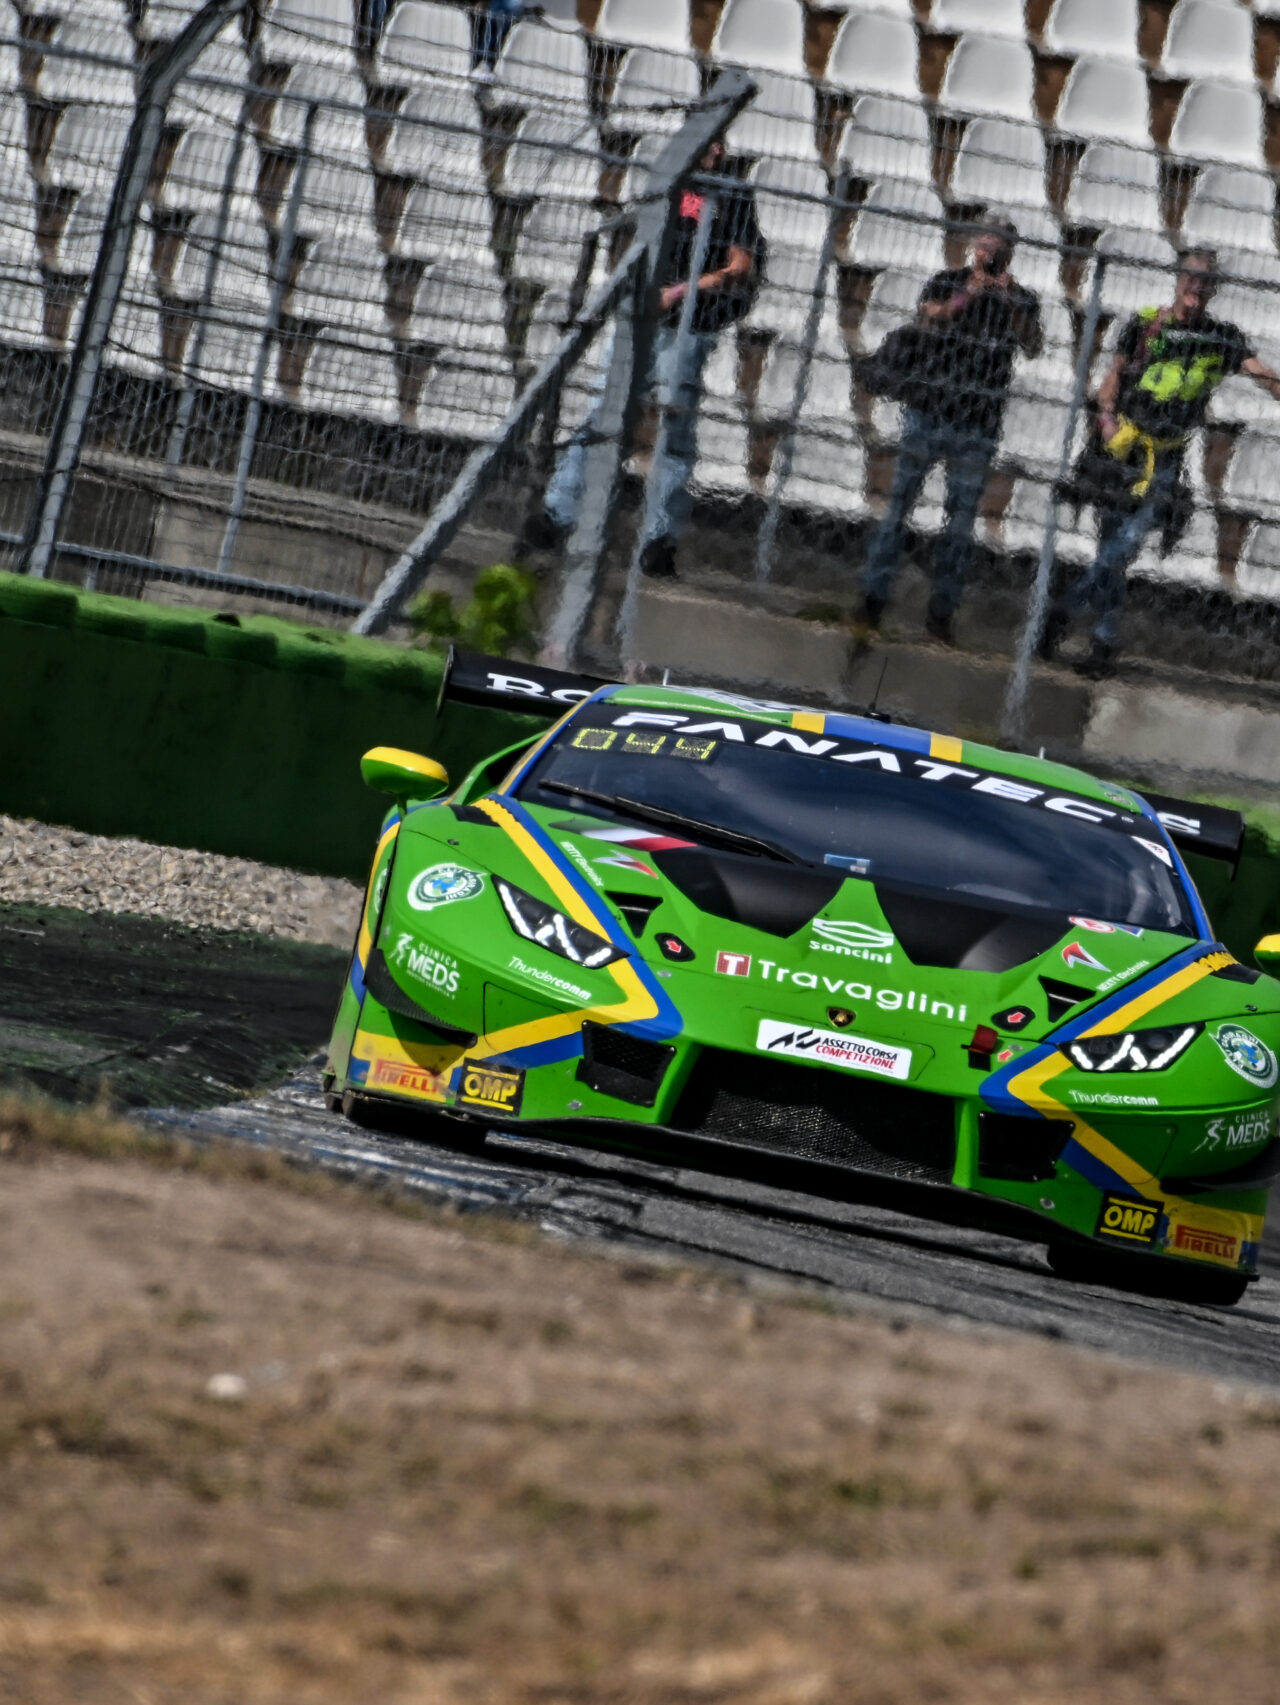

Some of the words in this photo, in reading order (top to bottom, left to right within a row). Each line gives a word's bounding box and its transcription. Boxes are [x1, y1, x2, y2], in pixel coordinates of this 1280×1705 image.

[571, 728, 717, 760] 044
[611, 711, 1118, 823] FANATEC
[418, 942, 458, 969] CLINICA
[809, 940, 893, 964] soncini
[406, 950, 461, 992] MEDS
[507, 956, 592, 1000] Thundercomm
[758, 959, 968, 1022] Travaglini
[815, 1045, 896, 1070] COMPETIZIONE
[821, 1037, 865, 1055] ASSETTO
[866, 1046, 899, 1061] CORSA
[373, 1058, 443, 1093] PIRELLI
[464, 1073, 517, 1103] OMP
[1068, 1088, 1159, 1106] Thundercomm
[1235, 1109, 1269, 1124] CLINICA
[1226, 1119, 1271, 1147] MEDS
[1104, 1205, 1156, 1235] OMP
[1175, 1224, 1237, 1260] PIRELLI
